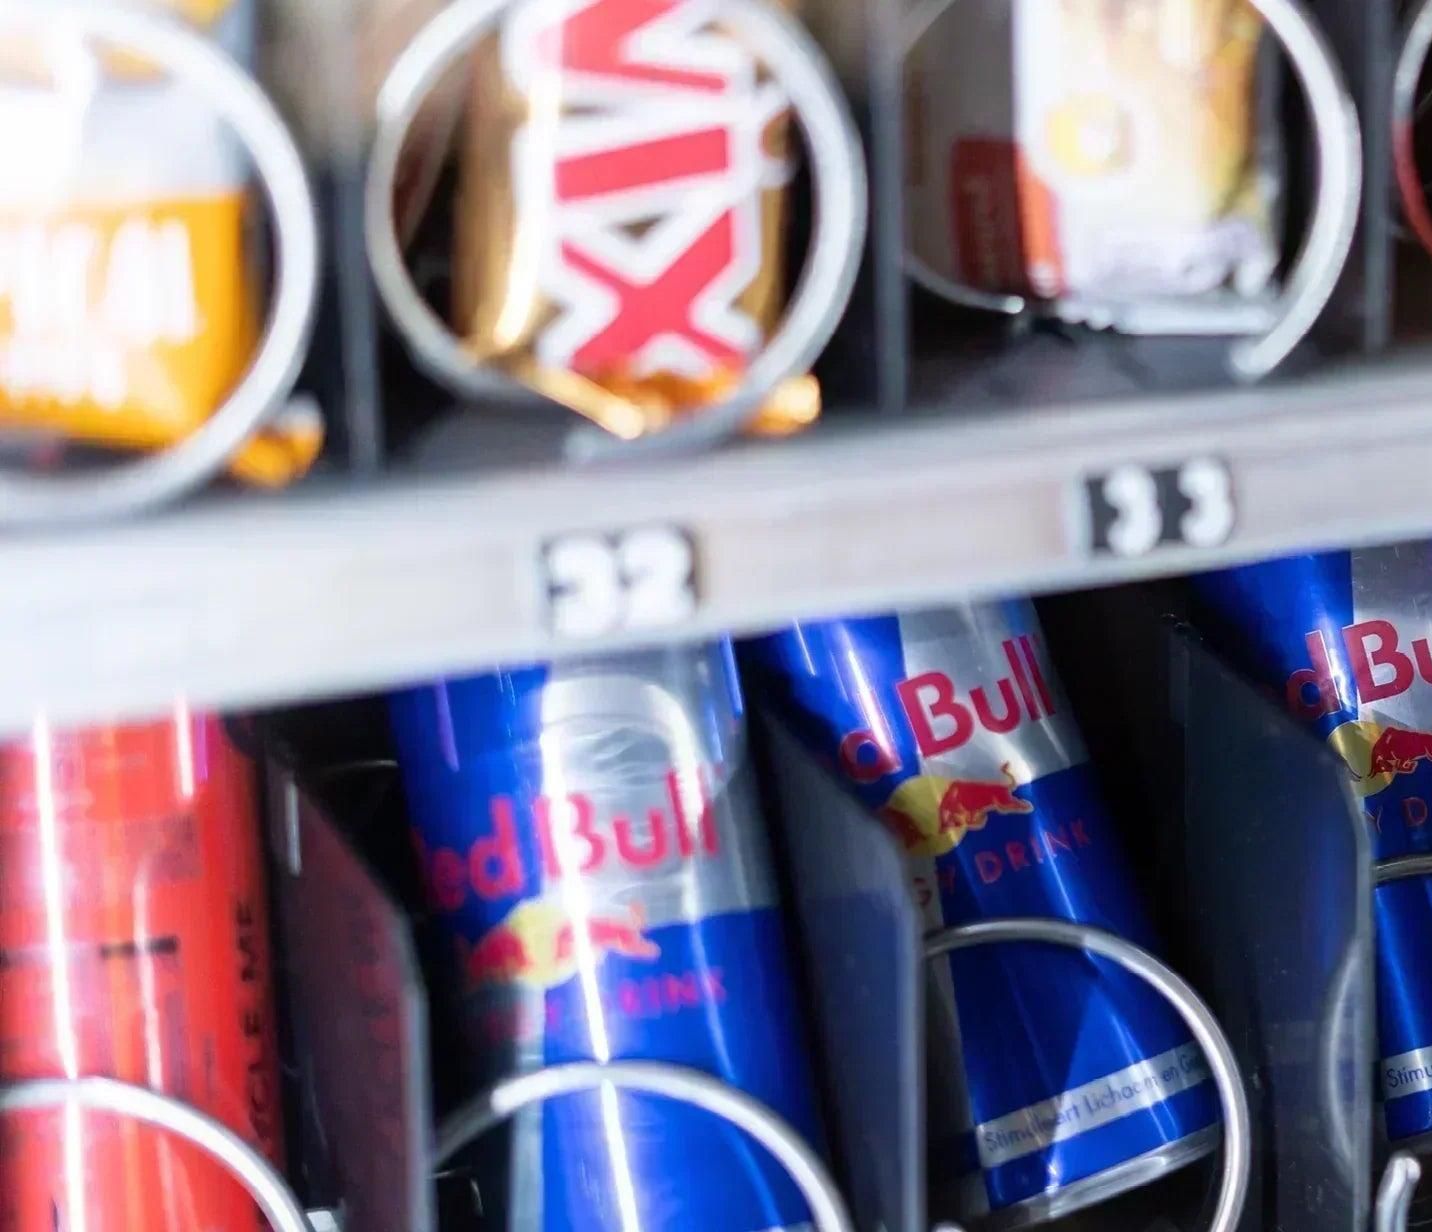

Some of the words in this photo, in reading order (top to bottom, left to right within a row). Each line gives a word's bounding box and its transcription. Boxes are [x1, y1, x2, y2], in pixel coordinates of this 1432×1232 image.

[1102, 456, 1235, 556] 33
[896, 633, 1057, 759] Bull
[412, 795, 523, 910] ed
[532, 768, 722, 882] Bull
[974, 819, 1092, 884] DRINK
